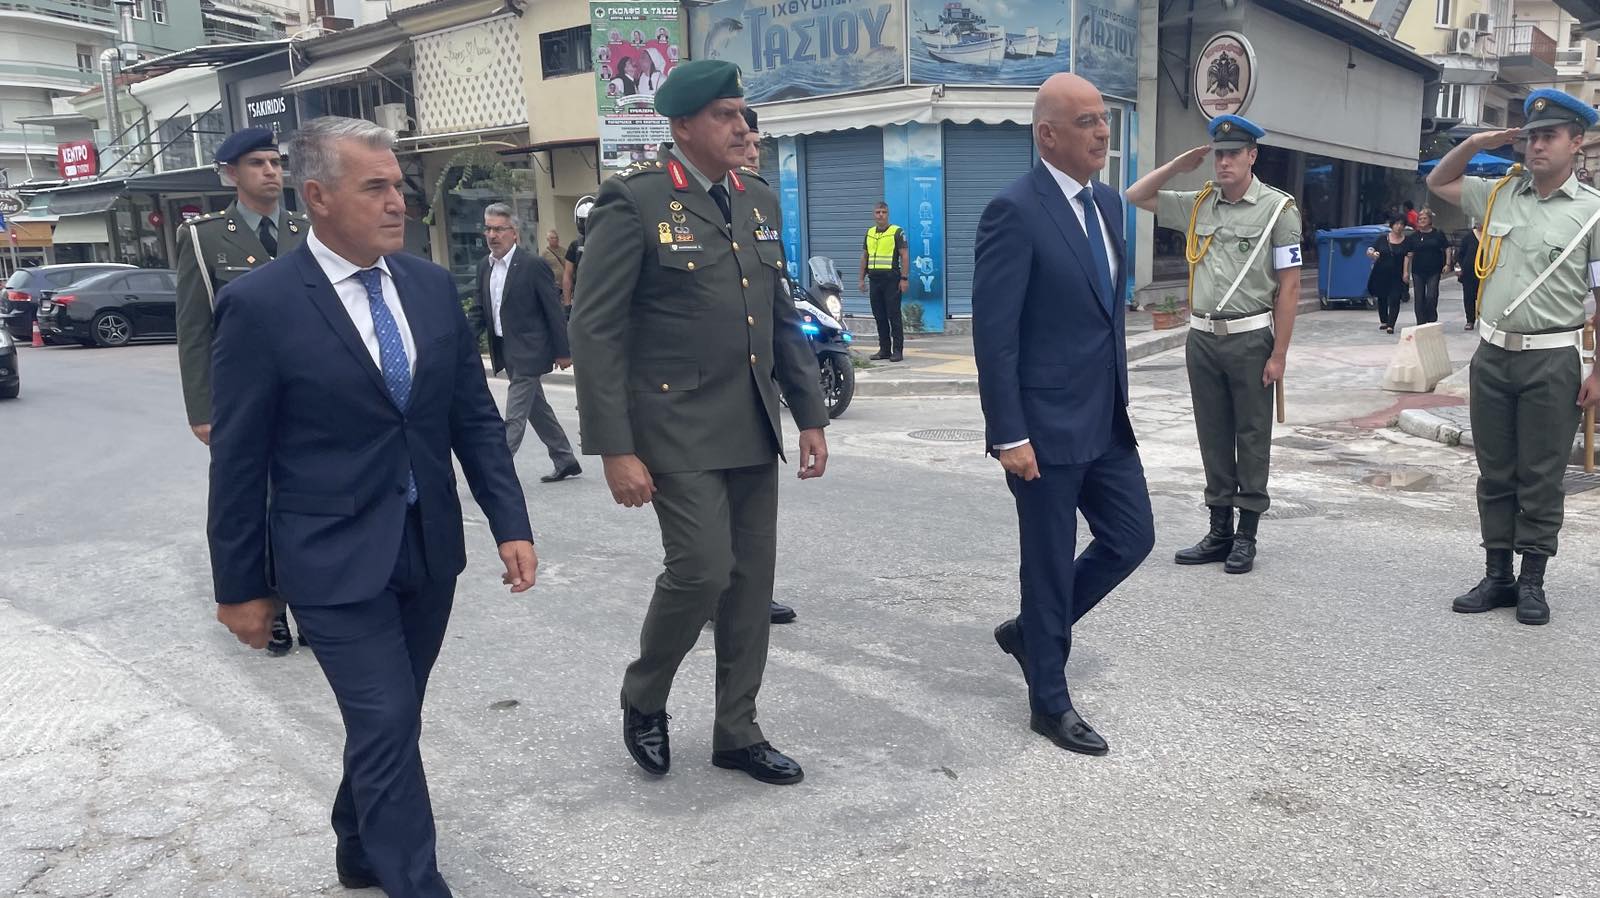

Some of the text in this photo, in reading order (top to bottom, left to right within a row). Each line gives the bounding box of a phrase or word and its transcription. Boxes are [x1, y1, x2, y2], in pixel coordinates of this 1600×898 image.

[650, 7, 678, 15] ΤΑΣΟΣ
[743, 4, 892, 72] ΤΑΣΙΟΥ
[247, 96, 286, 118] TSAKIRIDIS
[62, 144, 88, 164] ΚΕΝΤΡΟ
[918, 182, 935, 292] ΤΑΣΙΟΥ
[1288, 246, 1301, 264] Σ
[808, 307, 828, 321] POLICE
